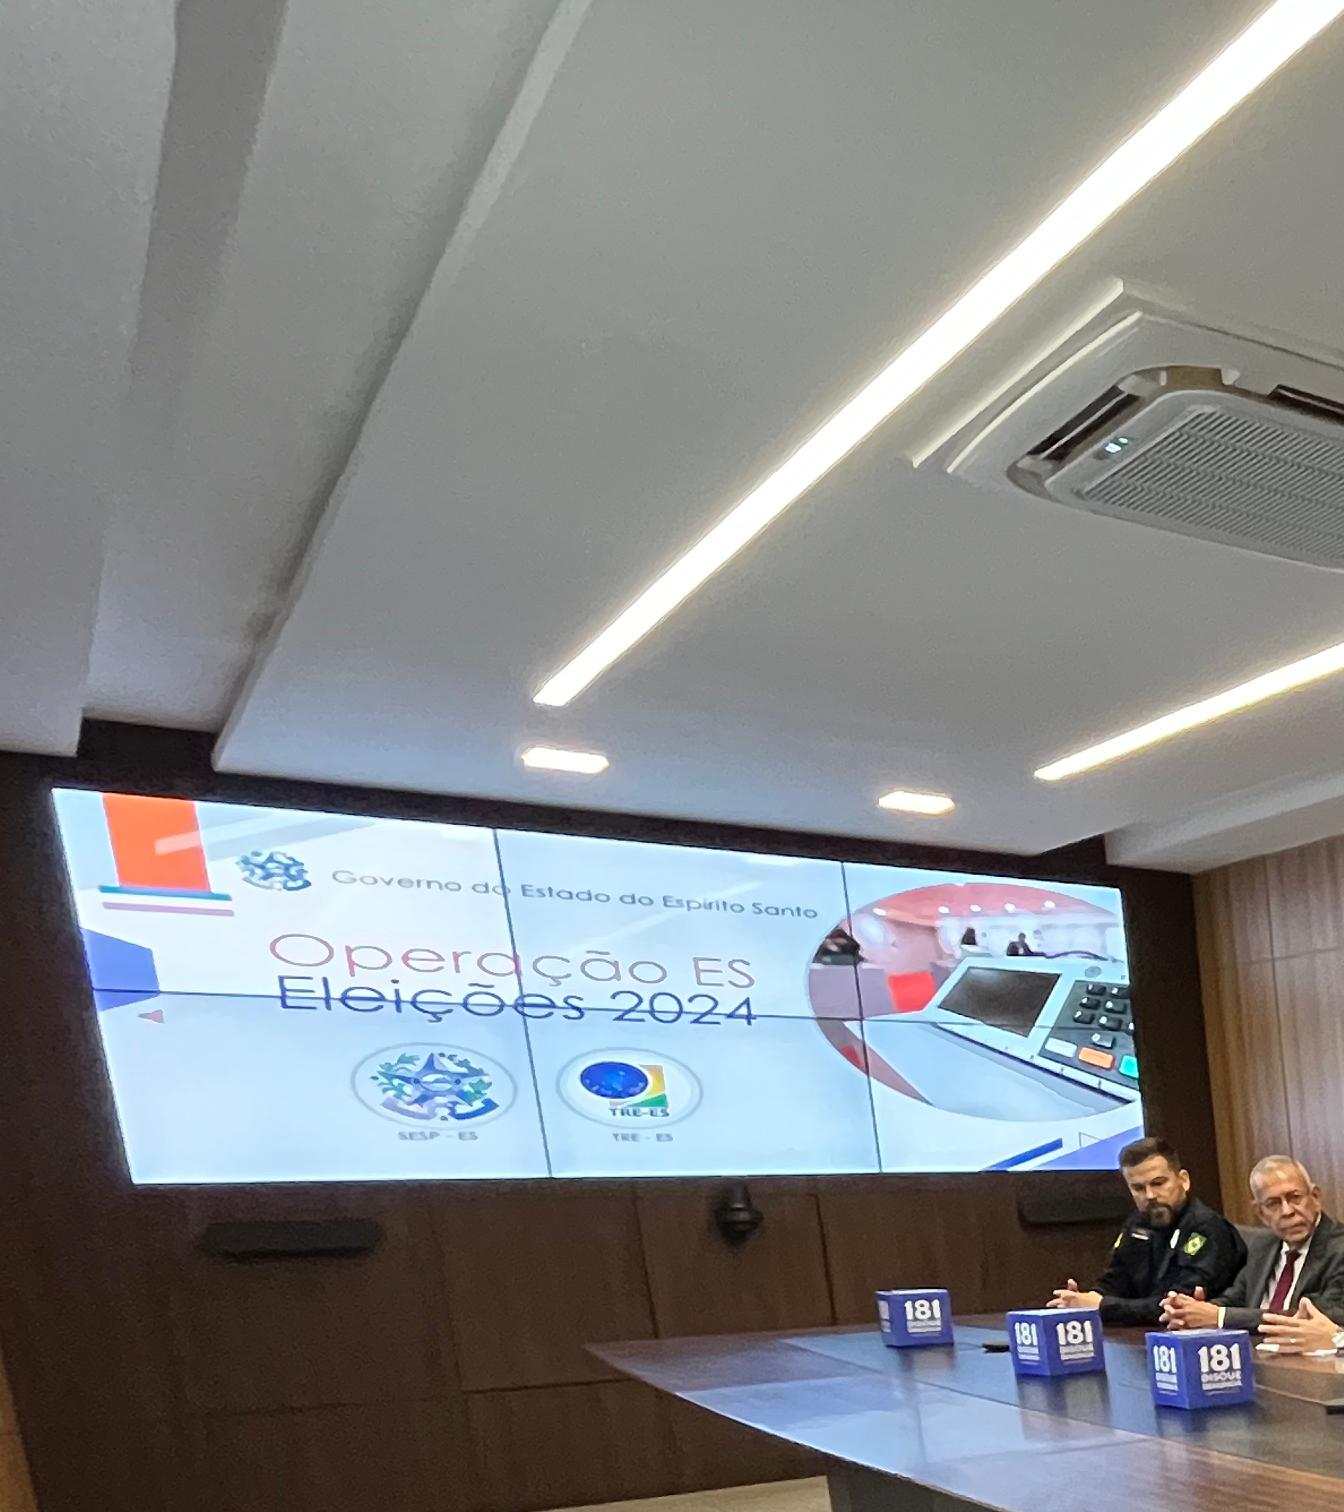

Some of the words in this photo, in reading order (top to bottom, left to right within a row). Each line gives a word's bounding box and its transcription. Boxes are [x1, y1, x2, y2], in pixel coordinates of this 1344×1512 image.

[332, 870, 462, 892] Governo
[472, 882, 511, 896] do
[521, 884, 610, 903] Estado
[619, 892, 654, 906] do
[752, 902, 818, 919] Santo
[270, 933, 667, 986] Operação
[693, 957, 755, 988] ES
[278, 975, 585, 1023] Eleições
[611, 990, 757, 1026] 2024
[904, 1299, 942, 1320] 181
[1014, 1322, 1038, 1346] 181
[1056, 1320, 1093, 1344] 181
[1153, 1345, 1177, 1374] 181
[1198, 1343, 1242, 1373] 181
